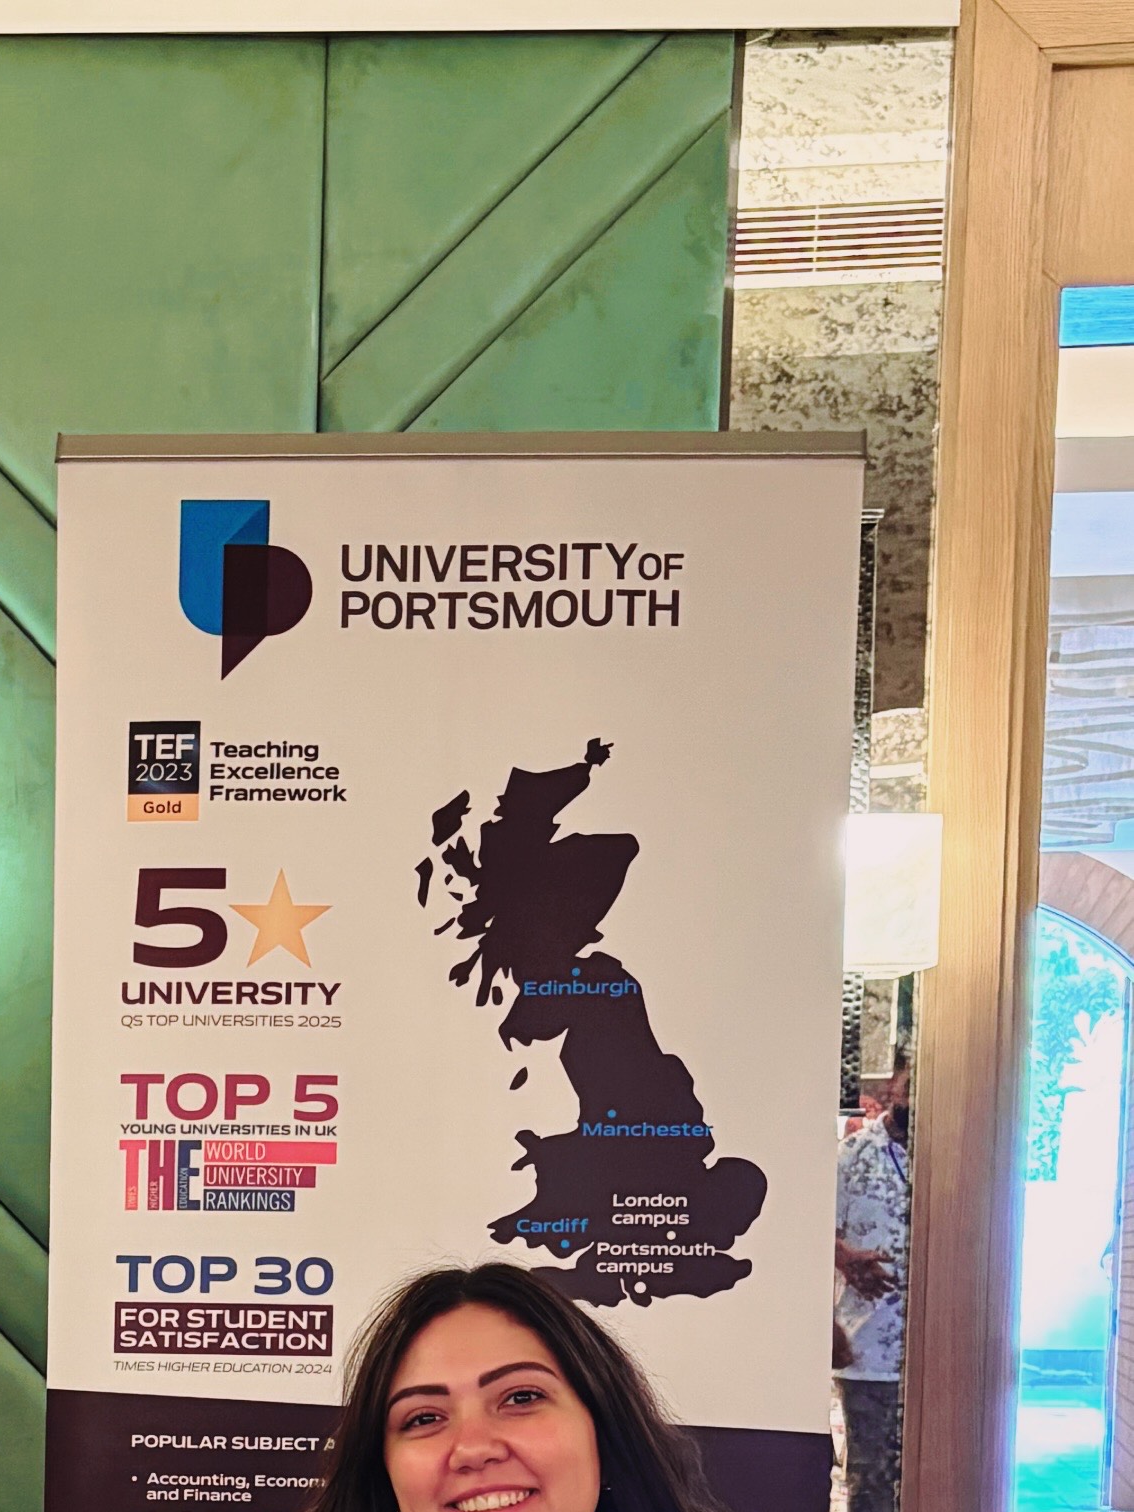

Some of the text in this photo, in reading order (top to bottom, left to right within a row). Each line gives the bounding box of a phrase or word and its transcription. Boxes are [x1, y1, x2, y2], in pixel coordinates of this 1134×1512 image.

[340, 542, 685, 583] UNIVERSITY OF
[340, 589, 681, 629] PORTSMOUTH
[134, 734, 196, 760] TEF
[210, 741, 319, 762] Teaching
[135, 763, 193, 782] 2023
[210, 763, 340, 780] Excellence
[209, 785, 348, 802] Framework
[143, 801, 182, 814] Gold
[133, 868, 228, 968] 5
[121, 981, 342, 1006] UNIVERSITY
[523, 979, 638, 998] Edinburgh
[121, 1014, 342, 1029] QS TOP UNIVERSITIES 2025
[120, 1073, 339, 1122] TOP 5
[120, 1124, 337, 1137] YOUNG UNIVERSITIES IN UK
[582, 1122, 714, 1137] Manchester
[206, 1142, 266, 1161] WORLD
[120, 1140, 202, 1211] THE
[206, 1167, 303, 1186] UNIVERSITY
[205, 1192, 292, 1211] RANKINGS
[612, 1193, 688, 1208] London
[516, 1218, 589, 1233] Cardiff
[611, 1213, 690, 1228] campus
[596, 1242, 716, 1257] Portsmouth
[116, 1255, 334, 1296] TOP 30
[596, 1261, 674, 1276] campus
[120, 1308, 328, 1330] FOR STUDENT
[119, 1330, 328, 1350] SATISFACTION
[113, 1361, 333, 1375] TIMES HIGHER EDUCATION 2024
[131, 1434, 227, 1449] POPULAR
[231, 1435, 320, 1451] SUBJECT
[146, 1472, 250, 1489] Accounting,
[146, 1489, 252, 1502] and Finance
